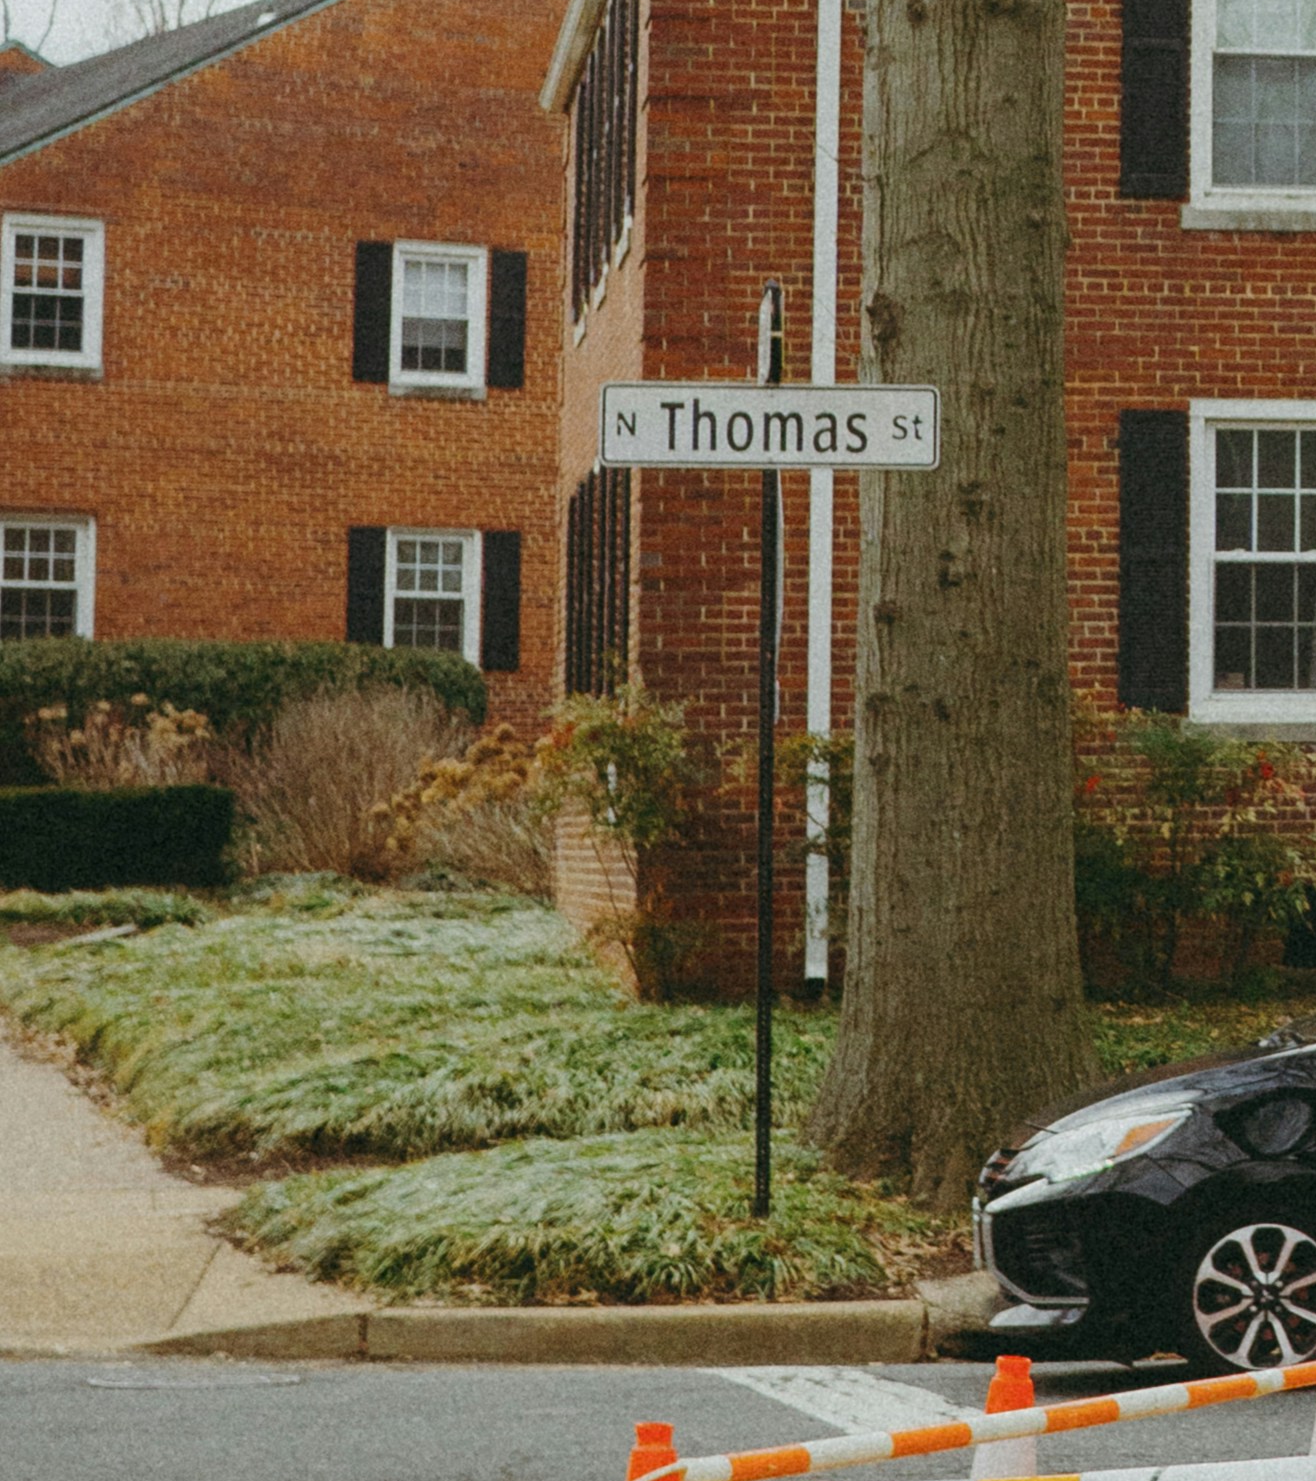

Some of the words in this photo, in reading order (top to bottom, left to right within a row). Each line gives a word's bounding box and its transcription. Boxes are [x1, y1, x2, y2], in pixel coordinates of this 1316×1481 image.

[616, 411, 637, 437] N
[660, 398, 868, 454] Thomas
[891, 413, 924, 441] St
